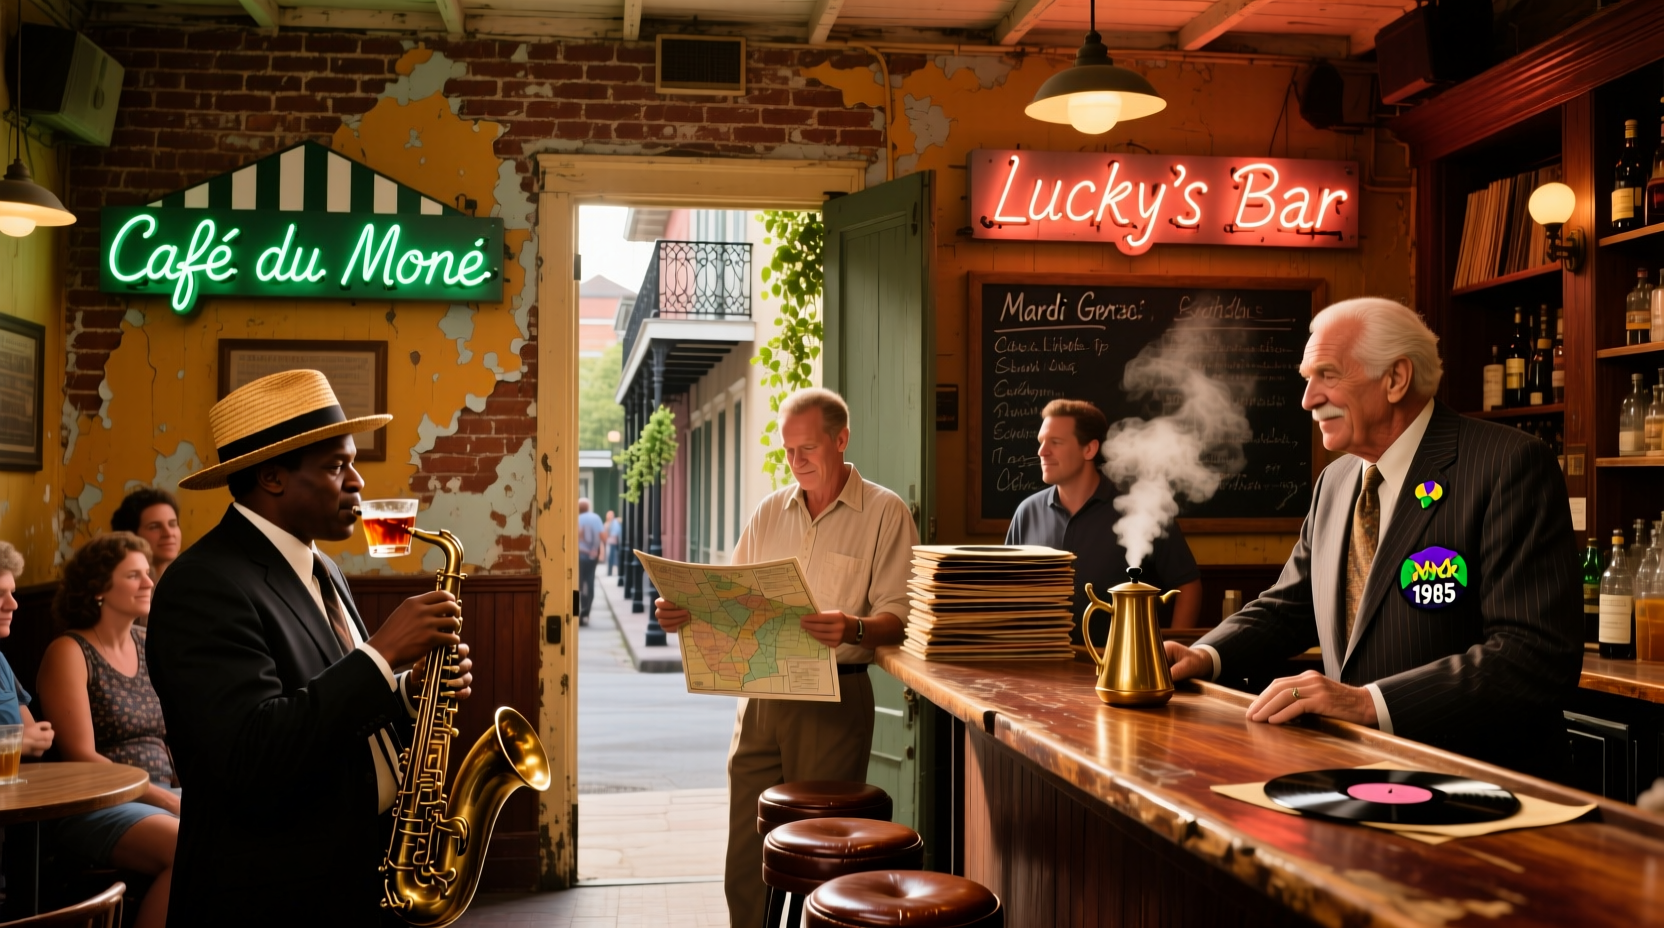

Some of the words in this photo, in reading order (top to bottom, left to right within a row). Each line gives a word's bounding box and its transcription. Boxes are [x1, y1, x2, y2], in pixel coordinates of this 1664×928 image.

[993, 155, 1208, 247] Lucky's
[1233, 163, 1348, 229] Bar
[109, 214, 239, 311] Café
[255, 223, 327, 282] du
[341, 223, 492, 286] Moné
[1000, 292, 1067, 322] Mardi
[1412, 582, 1456, 605] 1985
